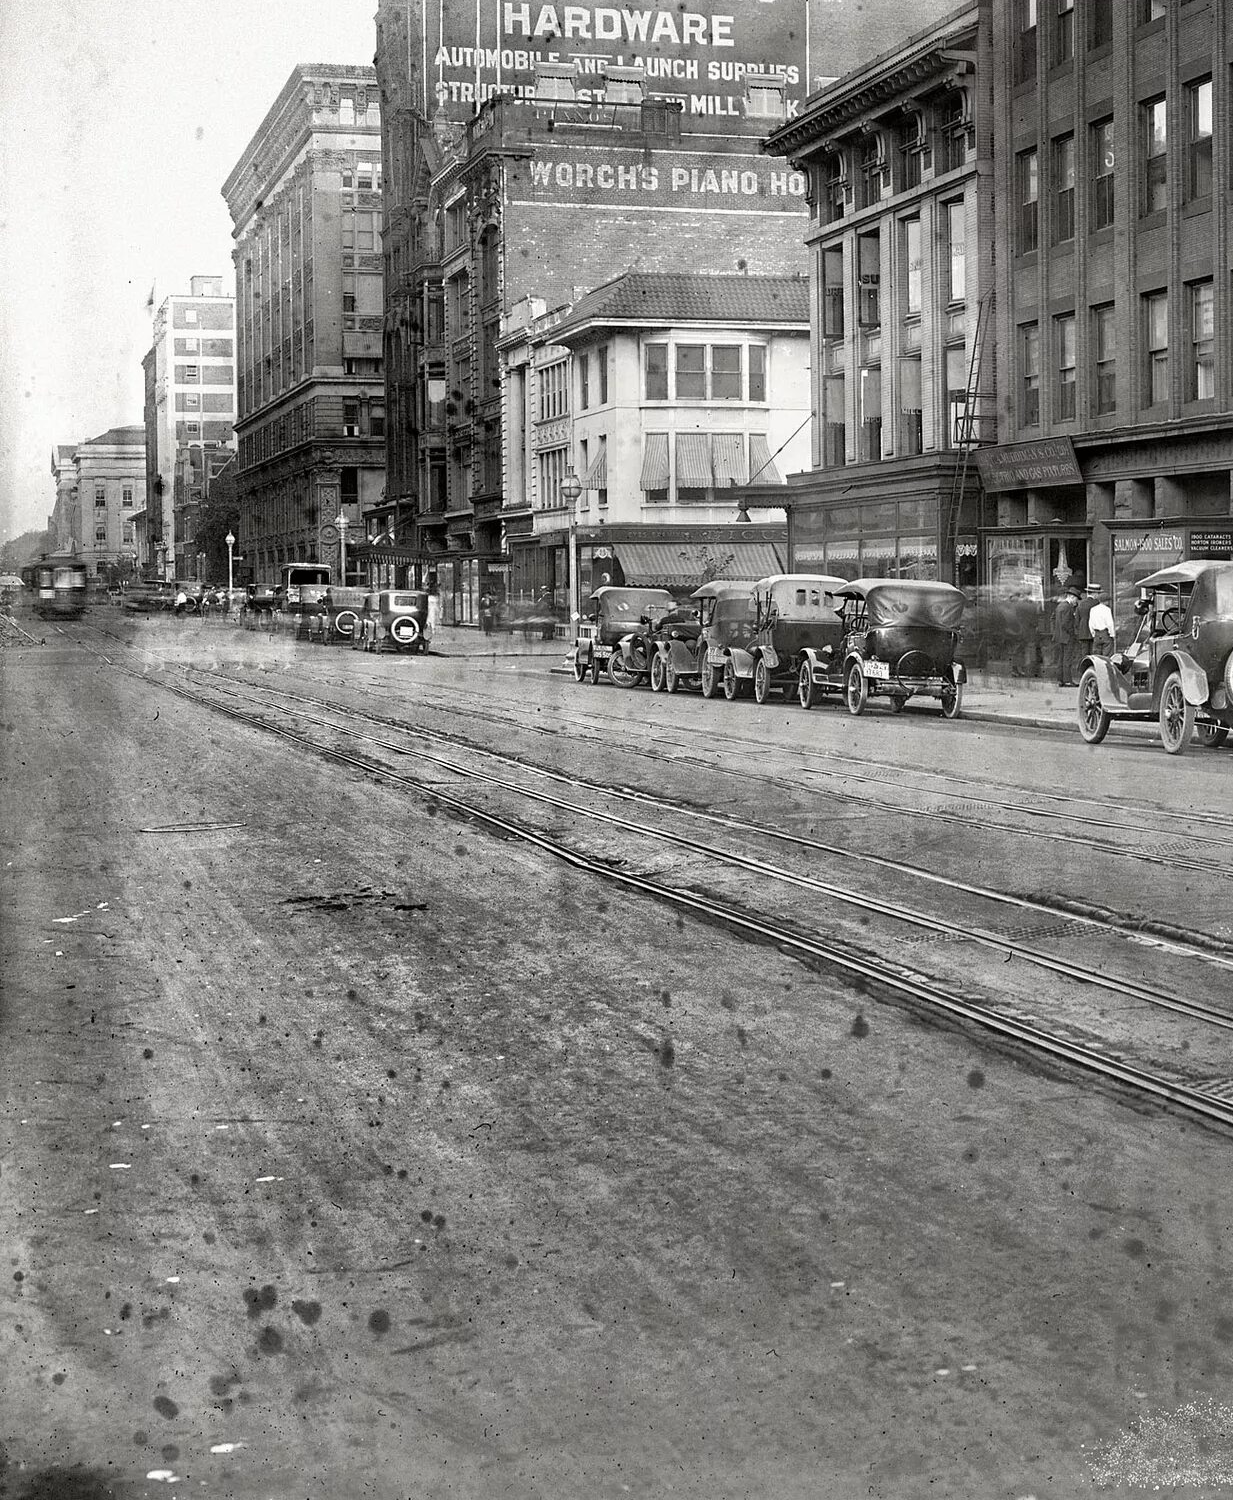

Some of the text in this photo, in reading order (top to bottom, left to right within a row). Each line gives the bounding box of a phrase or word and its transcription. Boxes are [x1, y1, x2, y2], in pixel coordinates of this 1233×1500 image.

[503, 3, 735, 47] HARDWARE
[530, 159, 659, 192] WORCH'S
[671, 167, 757, 196] PIANO
[1154, 537, 1173, 550] SALES
